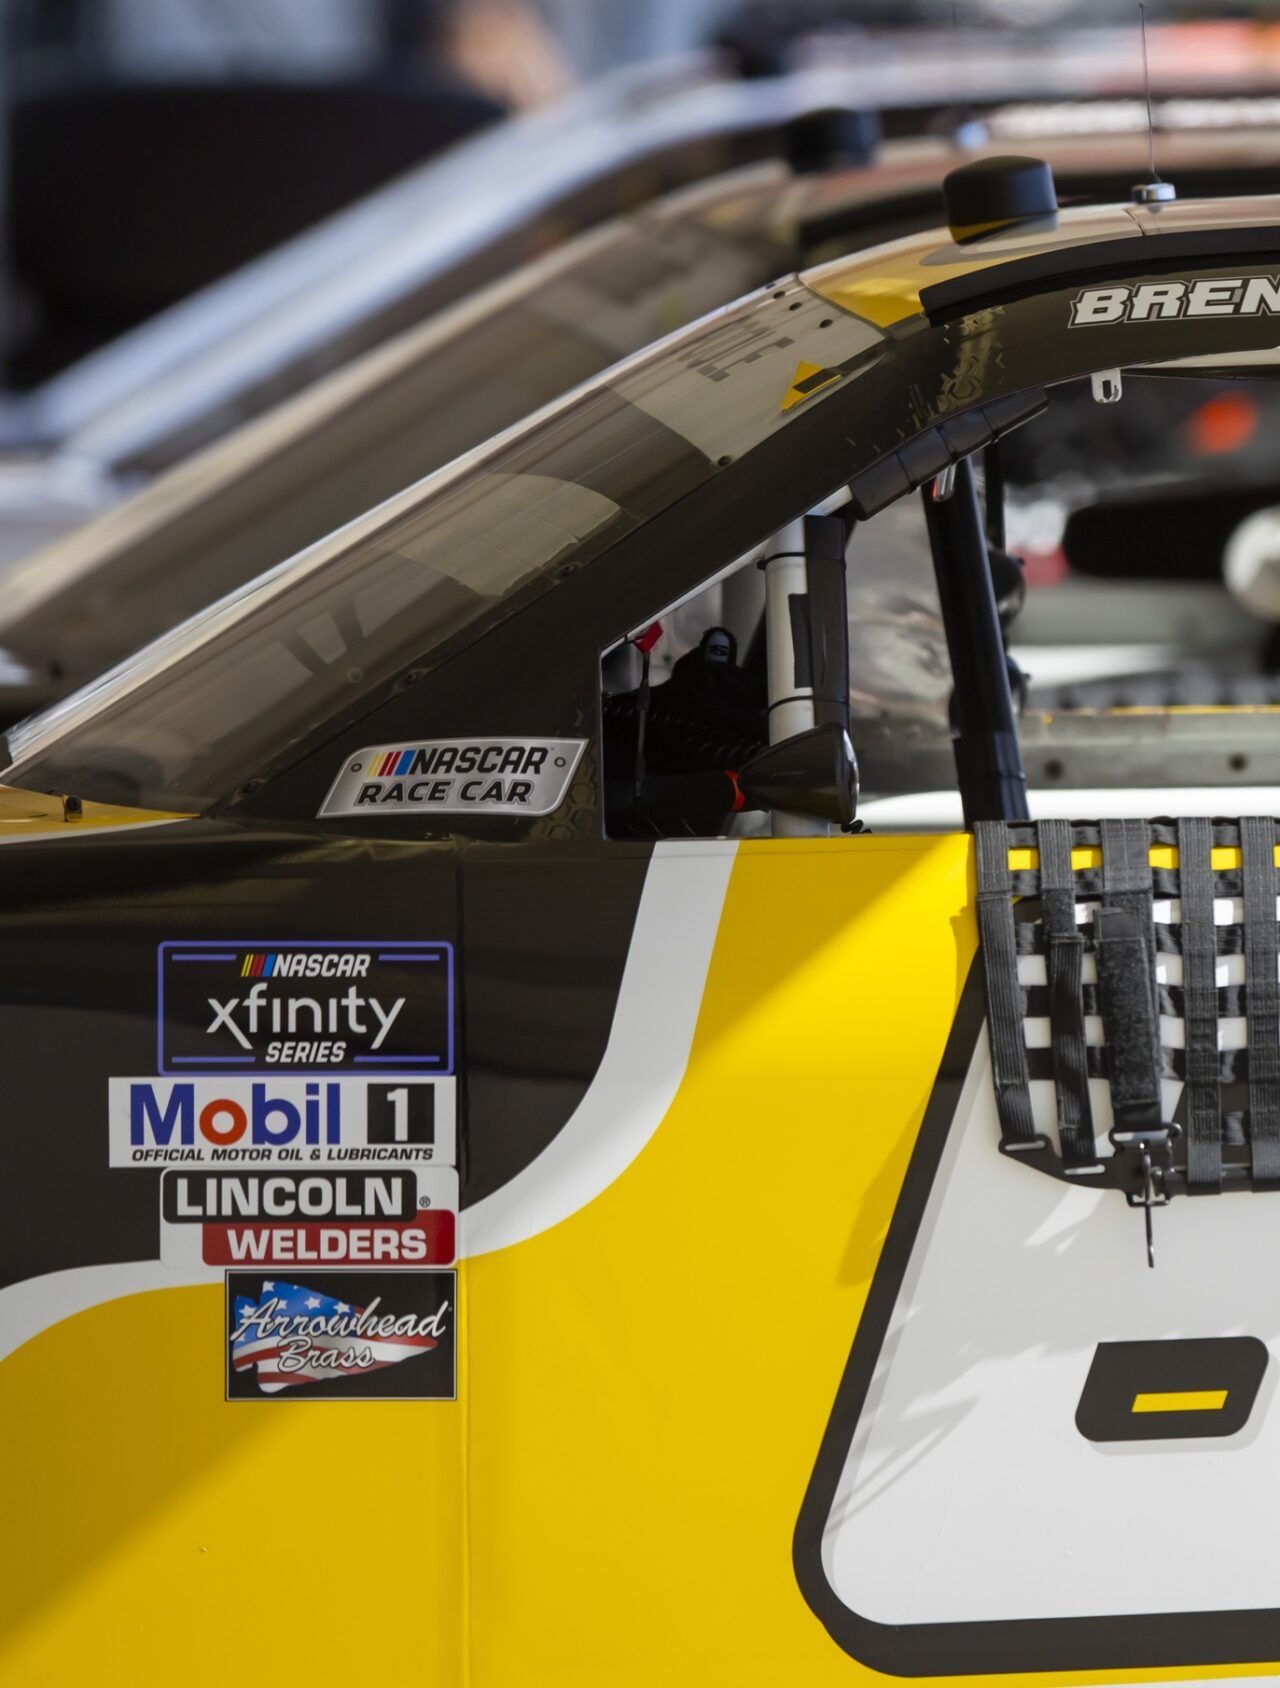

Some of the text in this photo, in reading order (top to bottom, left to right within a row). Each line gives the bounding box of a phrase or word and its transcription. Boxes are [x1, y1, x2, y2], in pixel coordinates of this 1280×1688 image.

[409, 747, 549, 775] NASCAR
[356, 779, 534, 805] RACE CAR
[272, 954, 371, 977] NASCAR
[206, 982, 406, 1050] xfinity
[265, 1042, 347, 1063] SERIES
[130, 1083, 408, 1146] Mobil 1
[132, 1148, 434, 1162] OFFICIAL MOTOR OIL & LUBRICANTS
[176, 1177, 402, 1216] LINCOLN
[227, 1228, 428, 1260] WELDERS
[230, 1296, 449, 1341] Arrowhead
[277, 1336, 375, 1373] Brass
